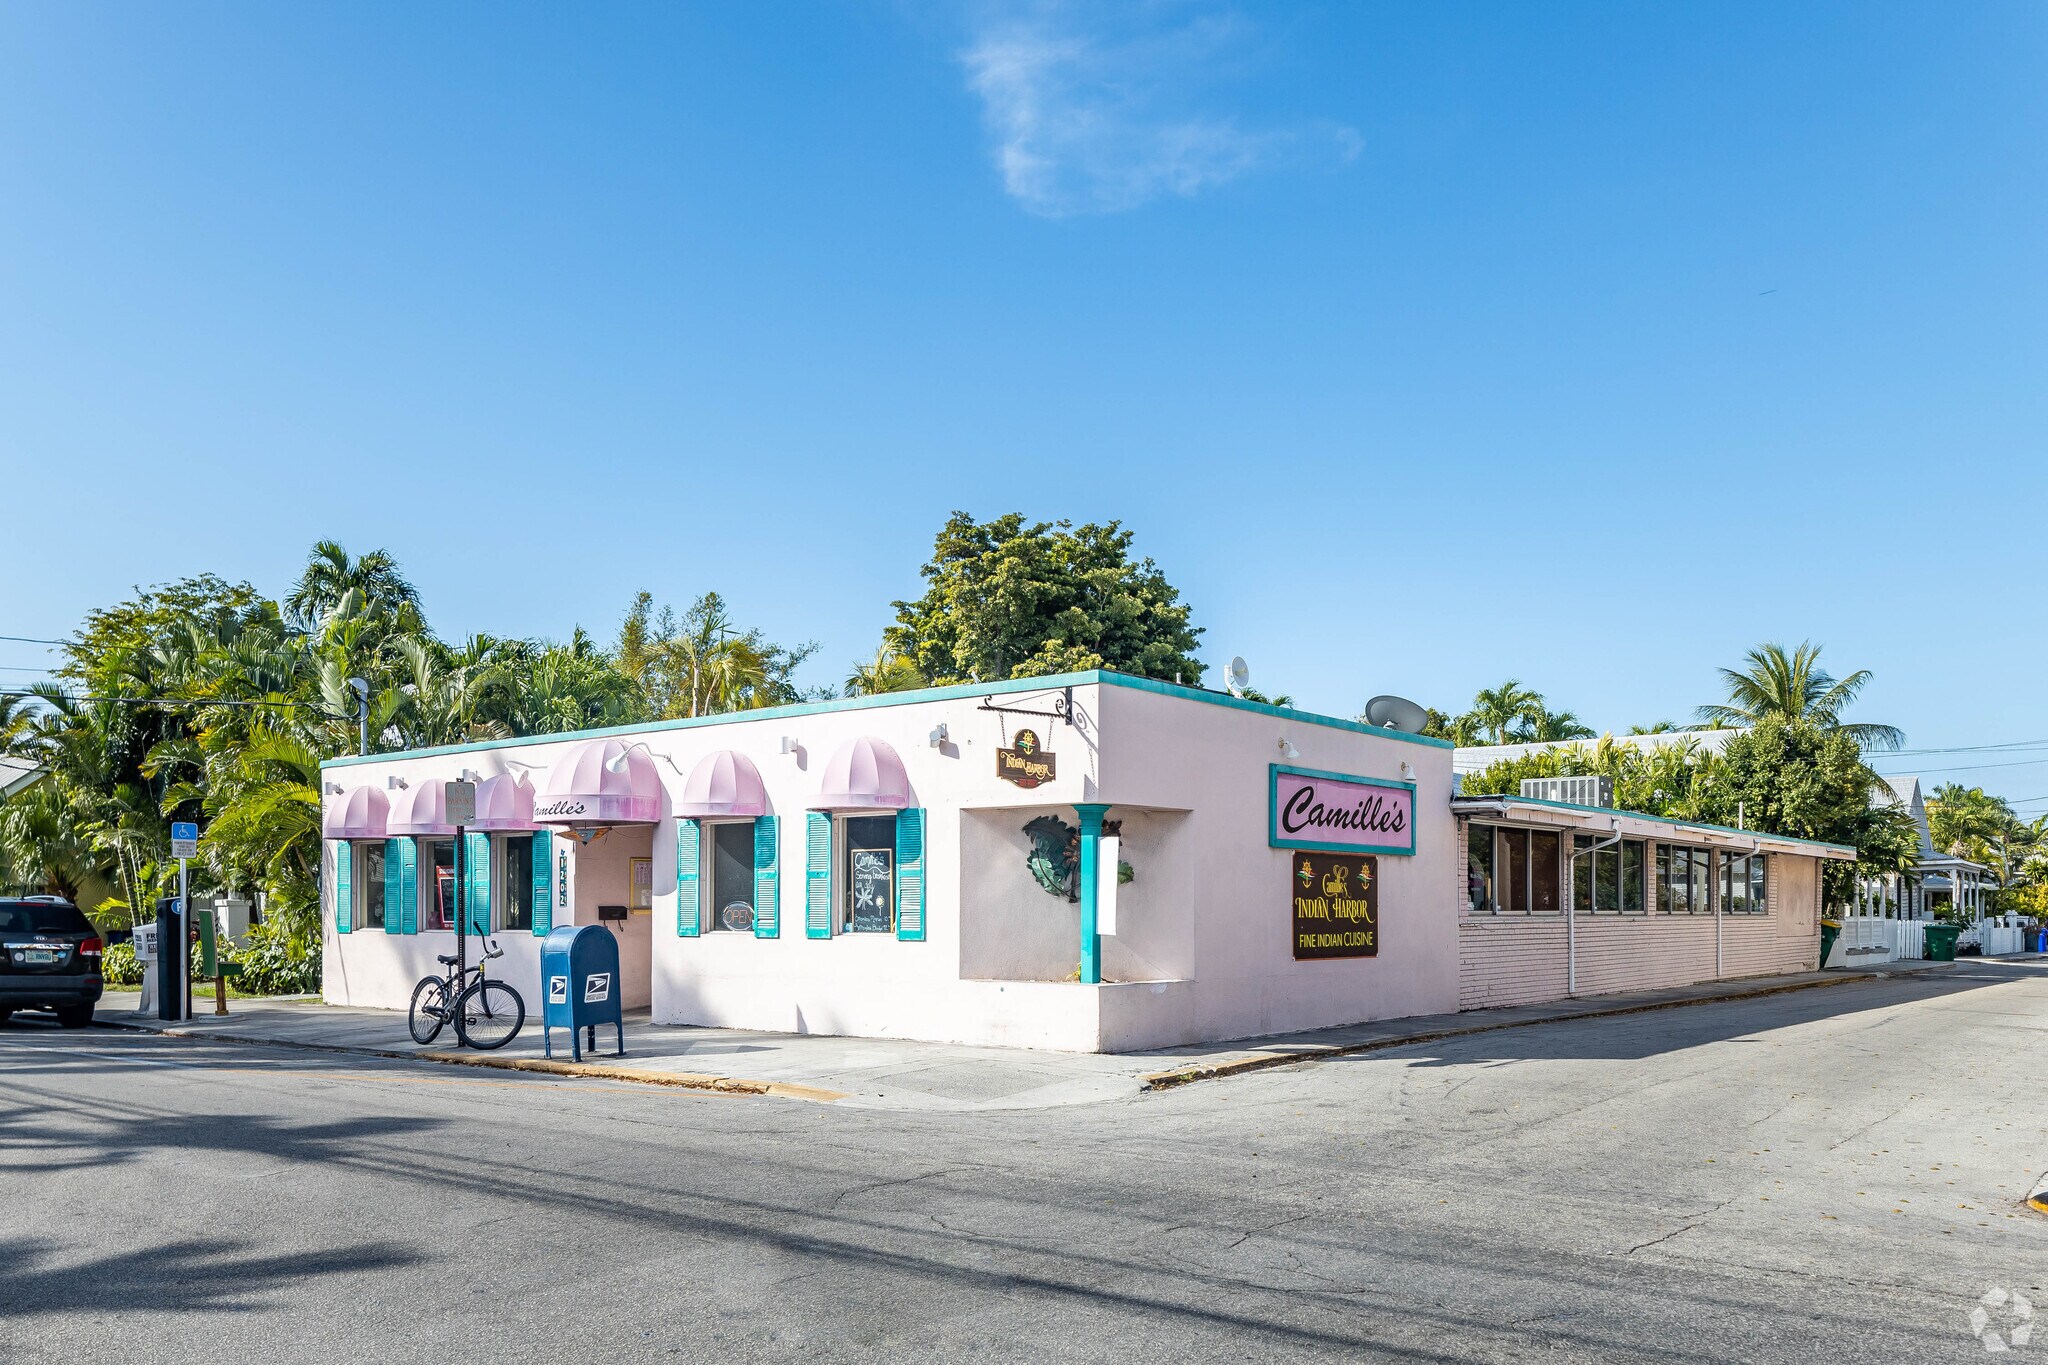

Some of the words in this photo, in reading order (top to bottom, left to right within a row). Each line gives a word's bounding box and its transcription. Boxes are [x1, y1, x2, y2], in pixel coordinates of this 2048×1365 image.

[534, 801, 587, 816] amille's
[1282, 786, 1406, 833] Camille's
[725, 910, 753, 924] OPEN
[1295, 897, 1333, 922] INDIAN
[1333, 898, 1376, 924] HARBOR
[1299, 934, 1316, 948] FINE
[1317, 934, 1343, 948] INDIAN
[1343, 931, 1373, 946] CUISINE
